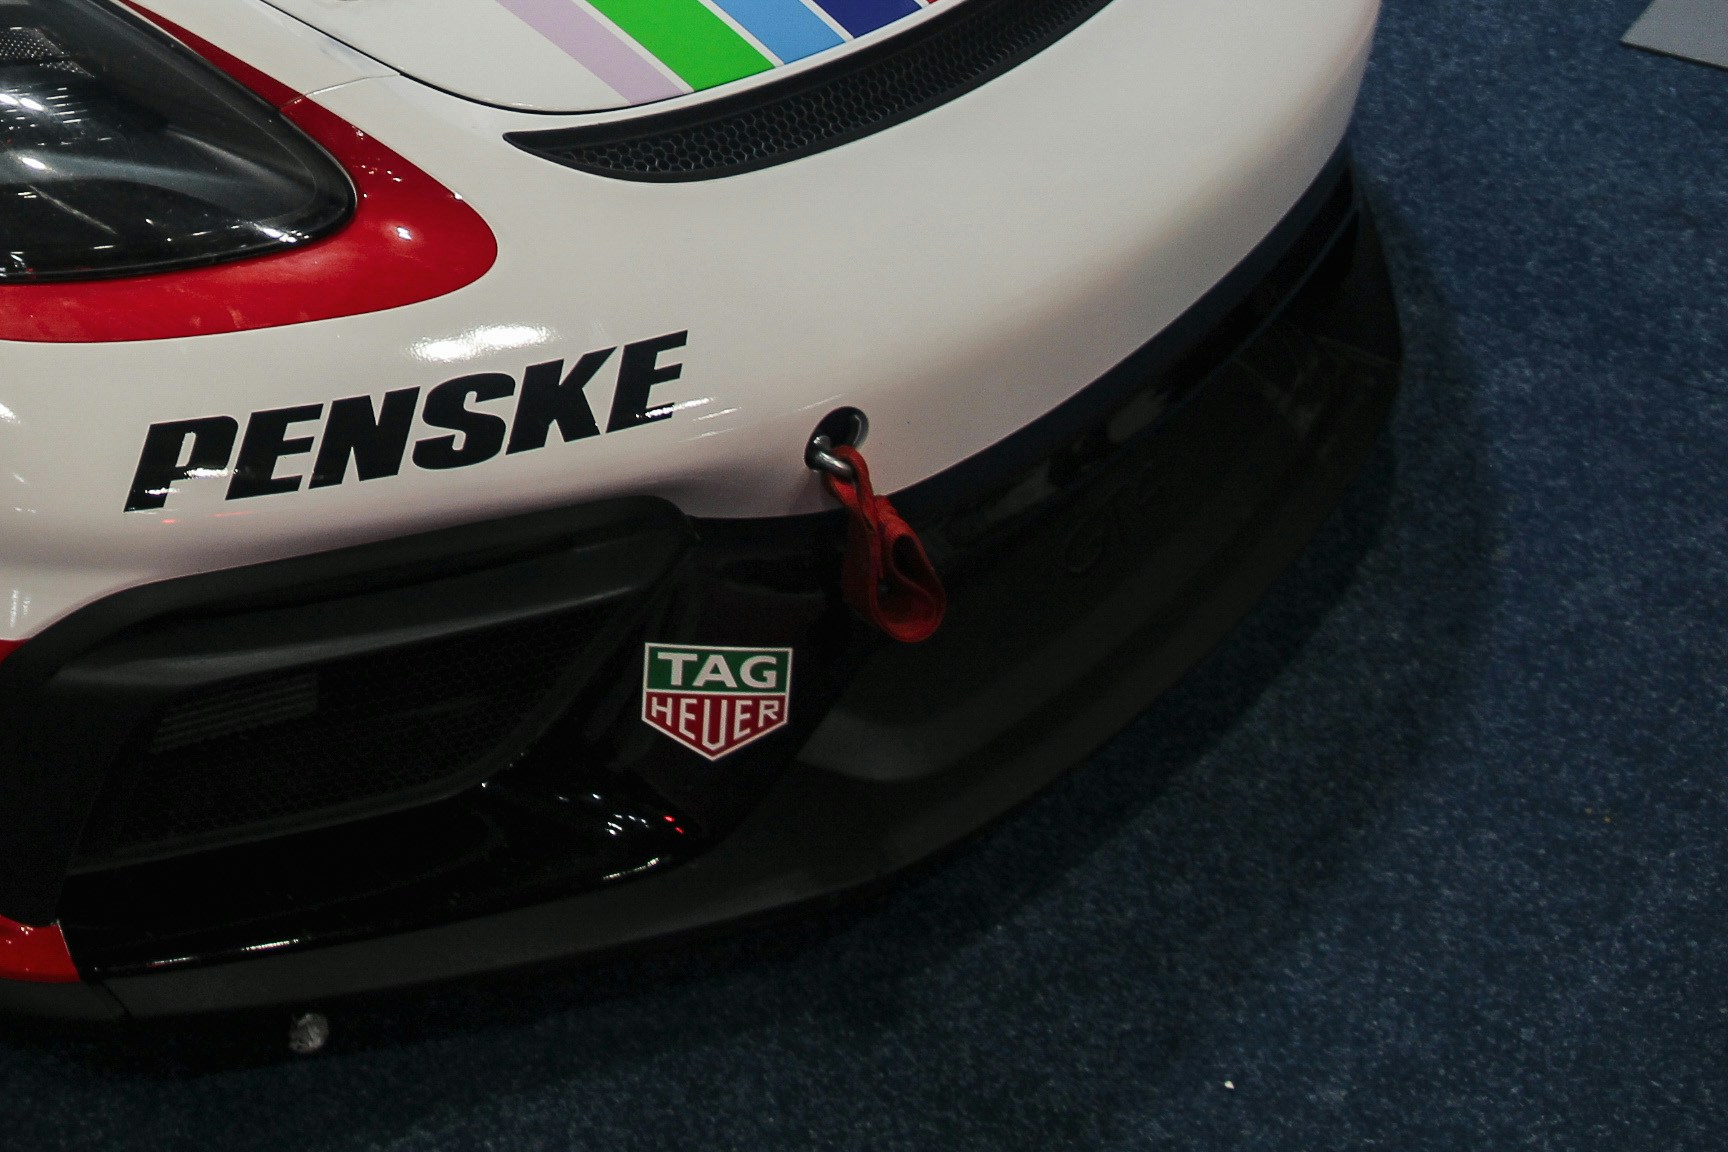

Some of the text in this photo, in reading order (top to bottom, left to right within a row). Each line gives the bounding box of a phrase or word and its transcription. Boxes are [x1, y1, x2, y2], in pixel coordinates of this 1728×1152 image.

[123, 330, 689, 512] PENSKE
[657, 652, 777, 689] TAG
[651, 696, 780, 750] HEUER
